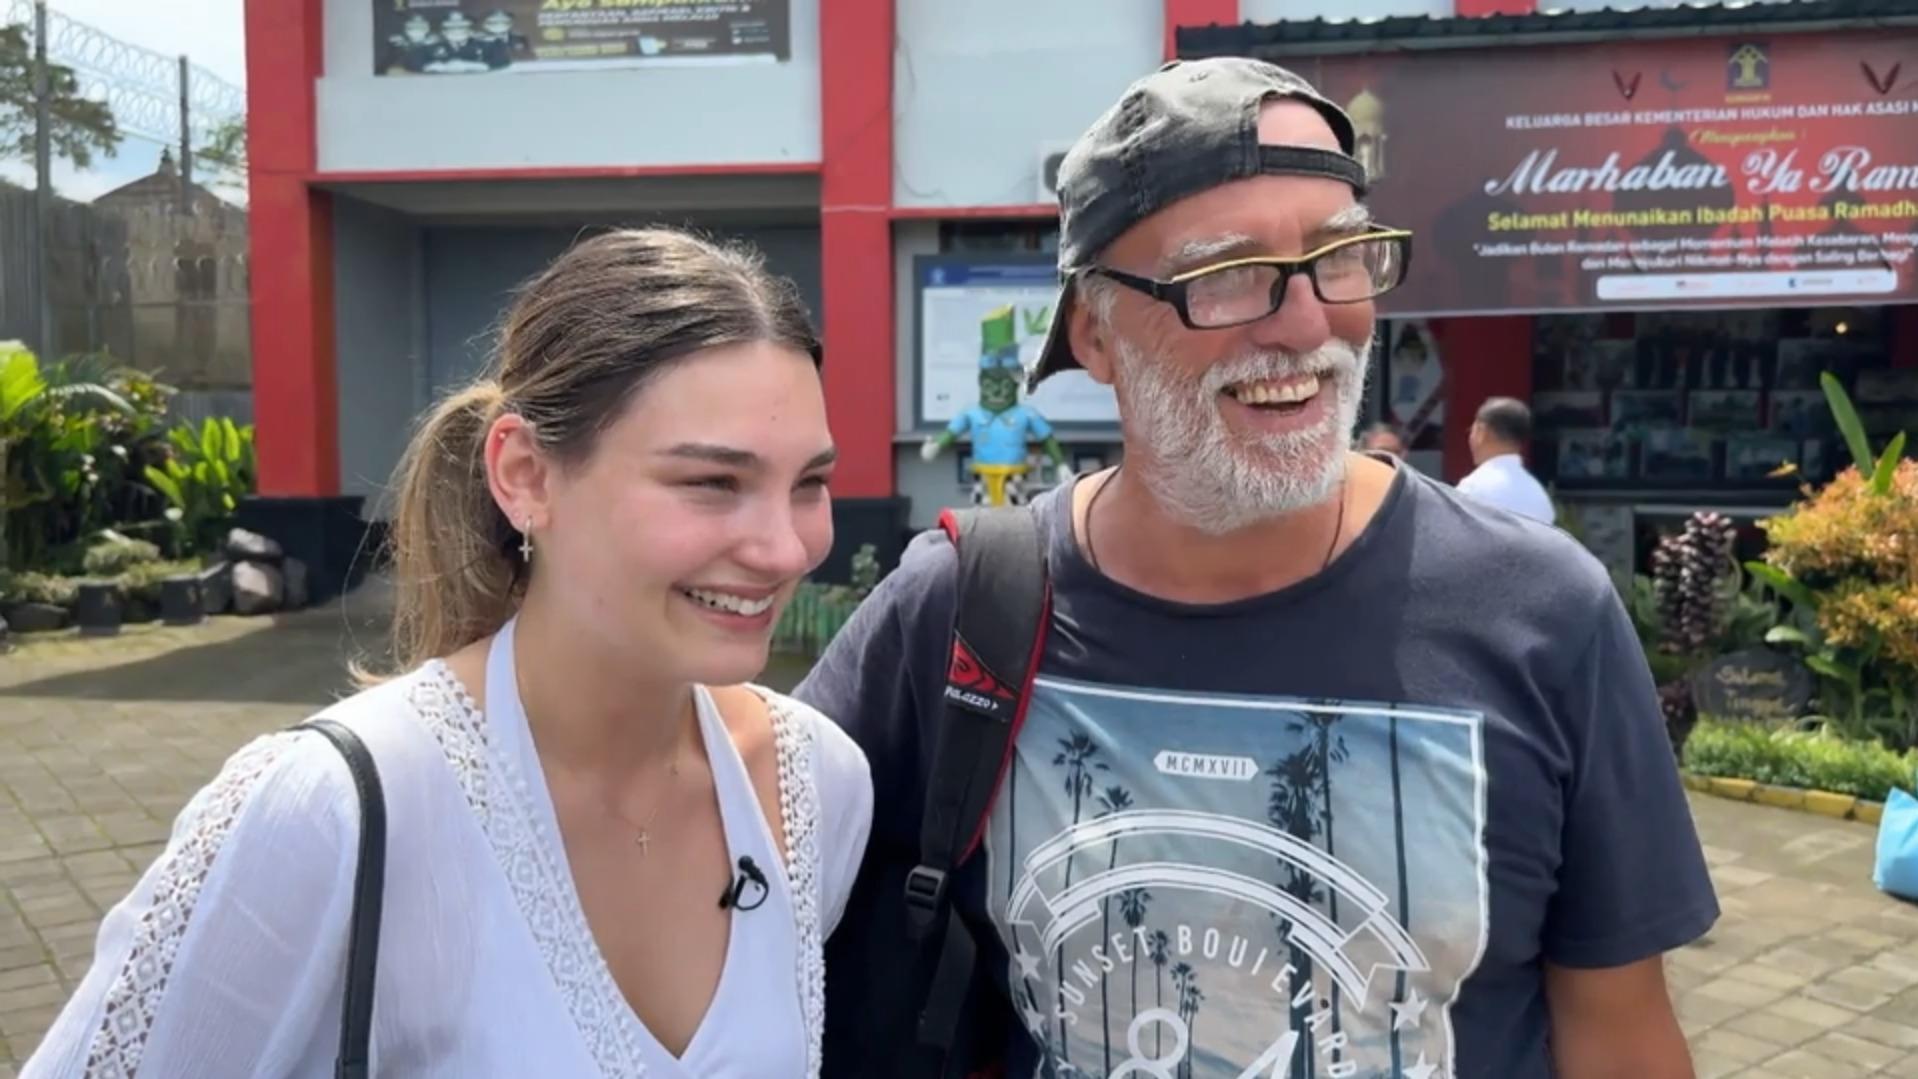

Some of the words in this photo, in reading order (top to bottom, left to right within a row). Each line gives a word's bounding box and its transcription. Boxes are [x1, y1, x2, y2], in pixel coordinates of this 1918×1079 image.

[1505, 113, 1581, 129] KELUARGA
[1584, 111, 1633, 127] BESAR
[1634, 108, 1738, 125] KEMENTERIAN
[1741, 105, 1795, 120] HUKUM
[1797, 103, 1828, 118] DAN
[1832, 102, 1863, 117] HAK
[1866, 100, 1909, 115] ASASI
[1484, 149, 1729, 196] Marhaban
[1741, 147, 1804, 194] Ya
[1488, 211, 1569, 231] Selamat
[1573, 207, 1692, 227] Menunaikan
[1697, 206, 1763, 224] Ibadah
[1768, 204, 1830, 221] Puasa
[1834, 200, 1918, 219] Ramadh
[1165, 755, 1248, 777] MCMXVII
[1055, 925, 1151, 1026] SUNSET
